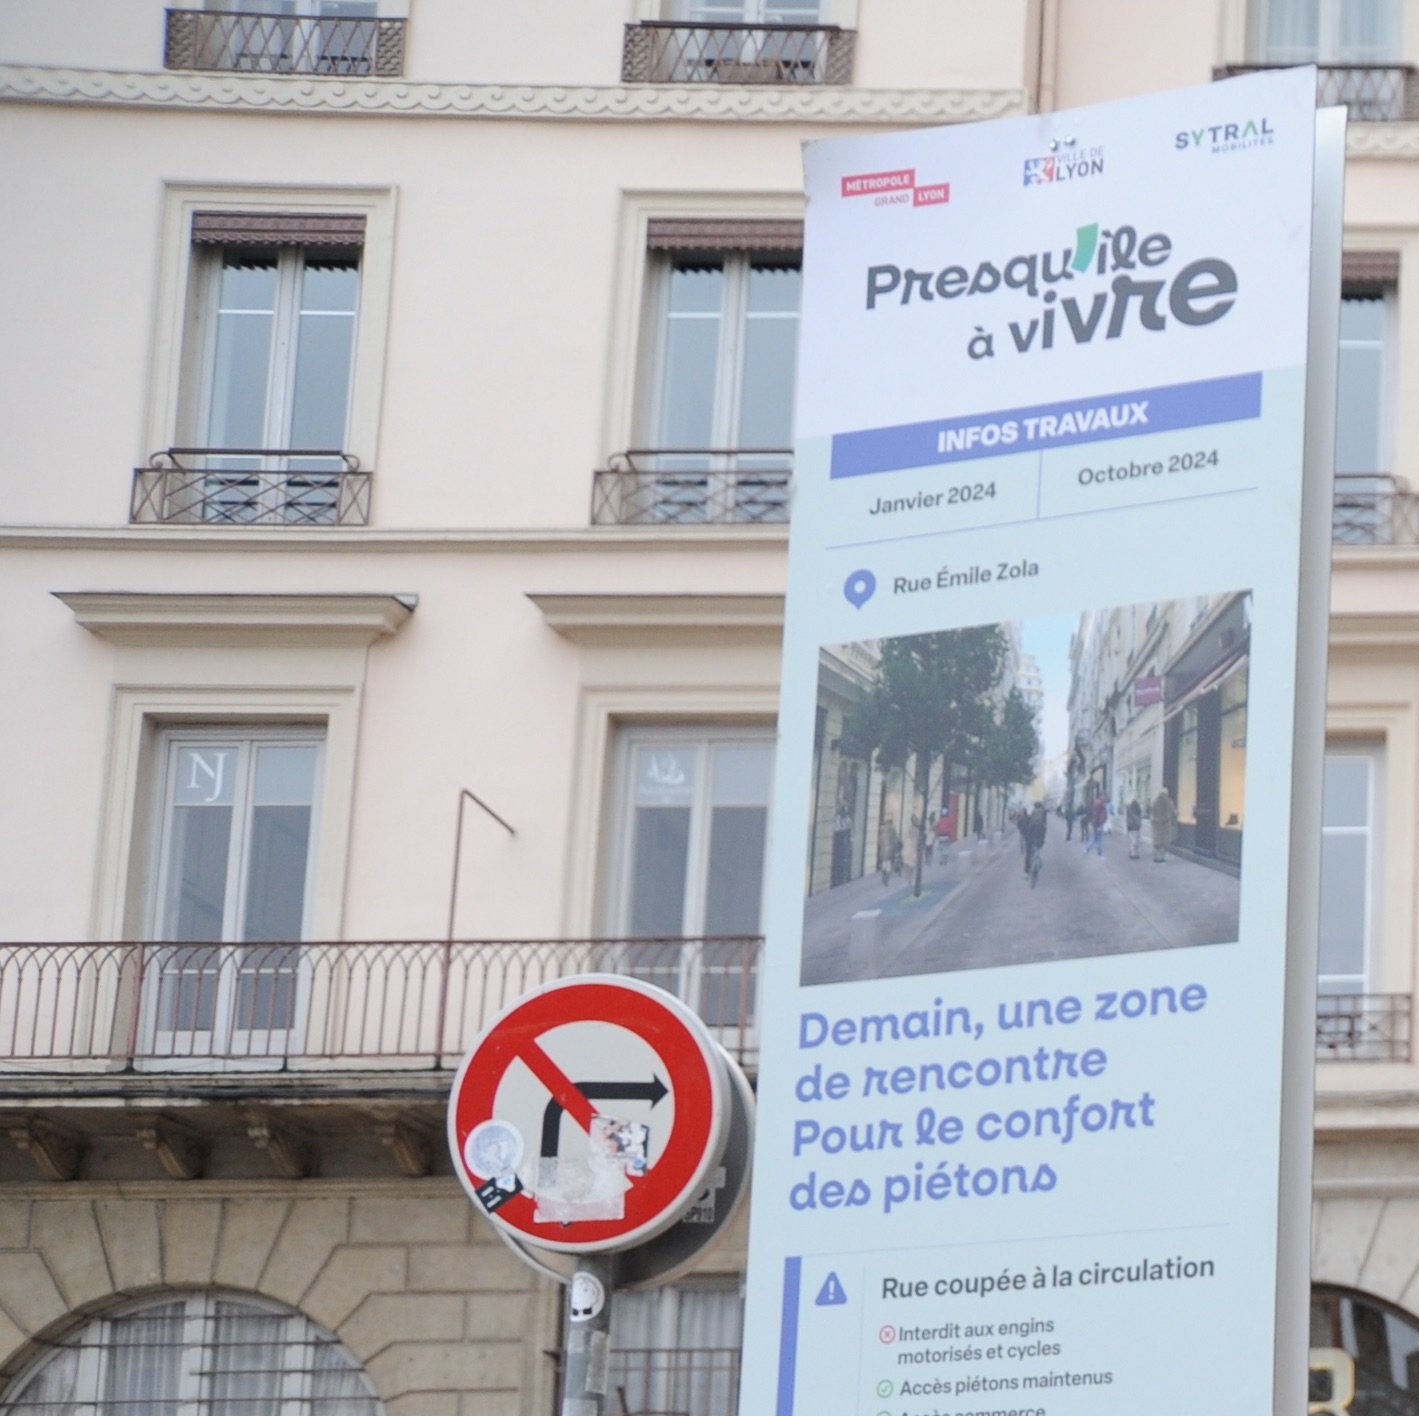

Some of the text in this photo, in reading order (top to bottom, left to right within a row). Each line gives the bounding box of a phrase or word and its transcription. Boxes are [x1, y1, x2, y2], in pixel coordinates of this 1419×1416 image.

[1055, 158, 1105, 181] LYON
[1057, 145, 1105, 164] VILLE DE
[874, 187, 945, 208] GRAND LYON
[967, 257, 1239, 360] à vivre
[938, 401, 1149, 453] INFOS TRAVAUX
[1078, 449, 1220, 486] Octobre 2024
[869, 481, 997, 516] Janvier 2024
[893, 559, 1040, 595] Rue Émile Zola
[799, 982, 1208, 1050] Demain, une zone
[795, 1046, 1108, 1102] de rencontre
[793, 1091, 1156, 1157] Pour le confort
[790, 1160, 1058, 1214] des piétons
[882, 1255, 1215, 1300] Rue coupée à la circulation
[899, 1317, 1055, 1343] Interdit aux engins
[897, 1340, 1061, 1366] motorisés et cycles
[900, 1369, 1113, 1397] Accès piétons maintenus
